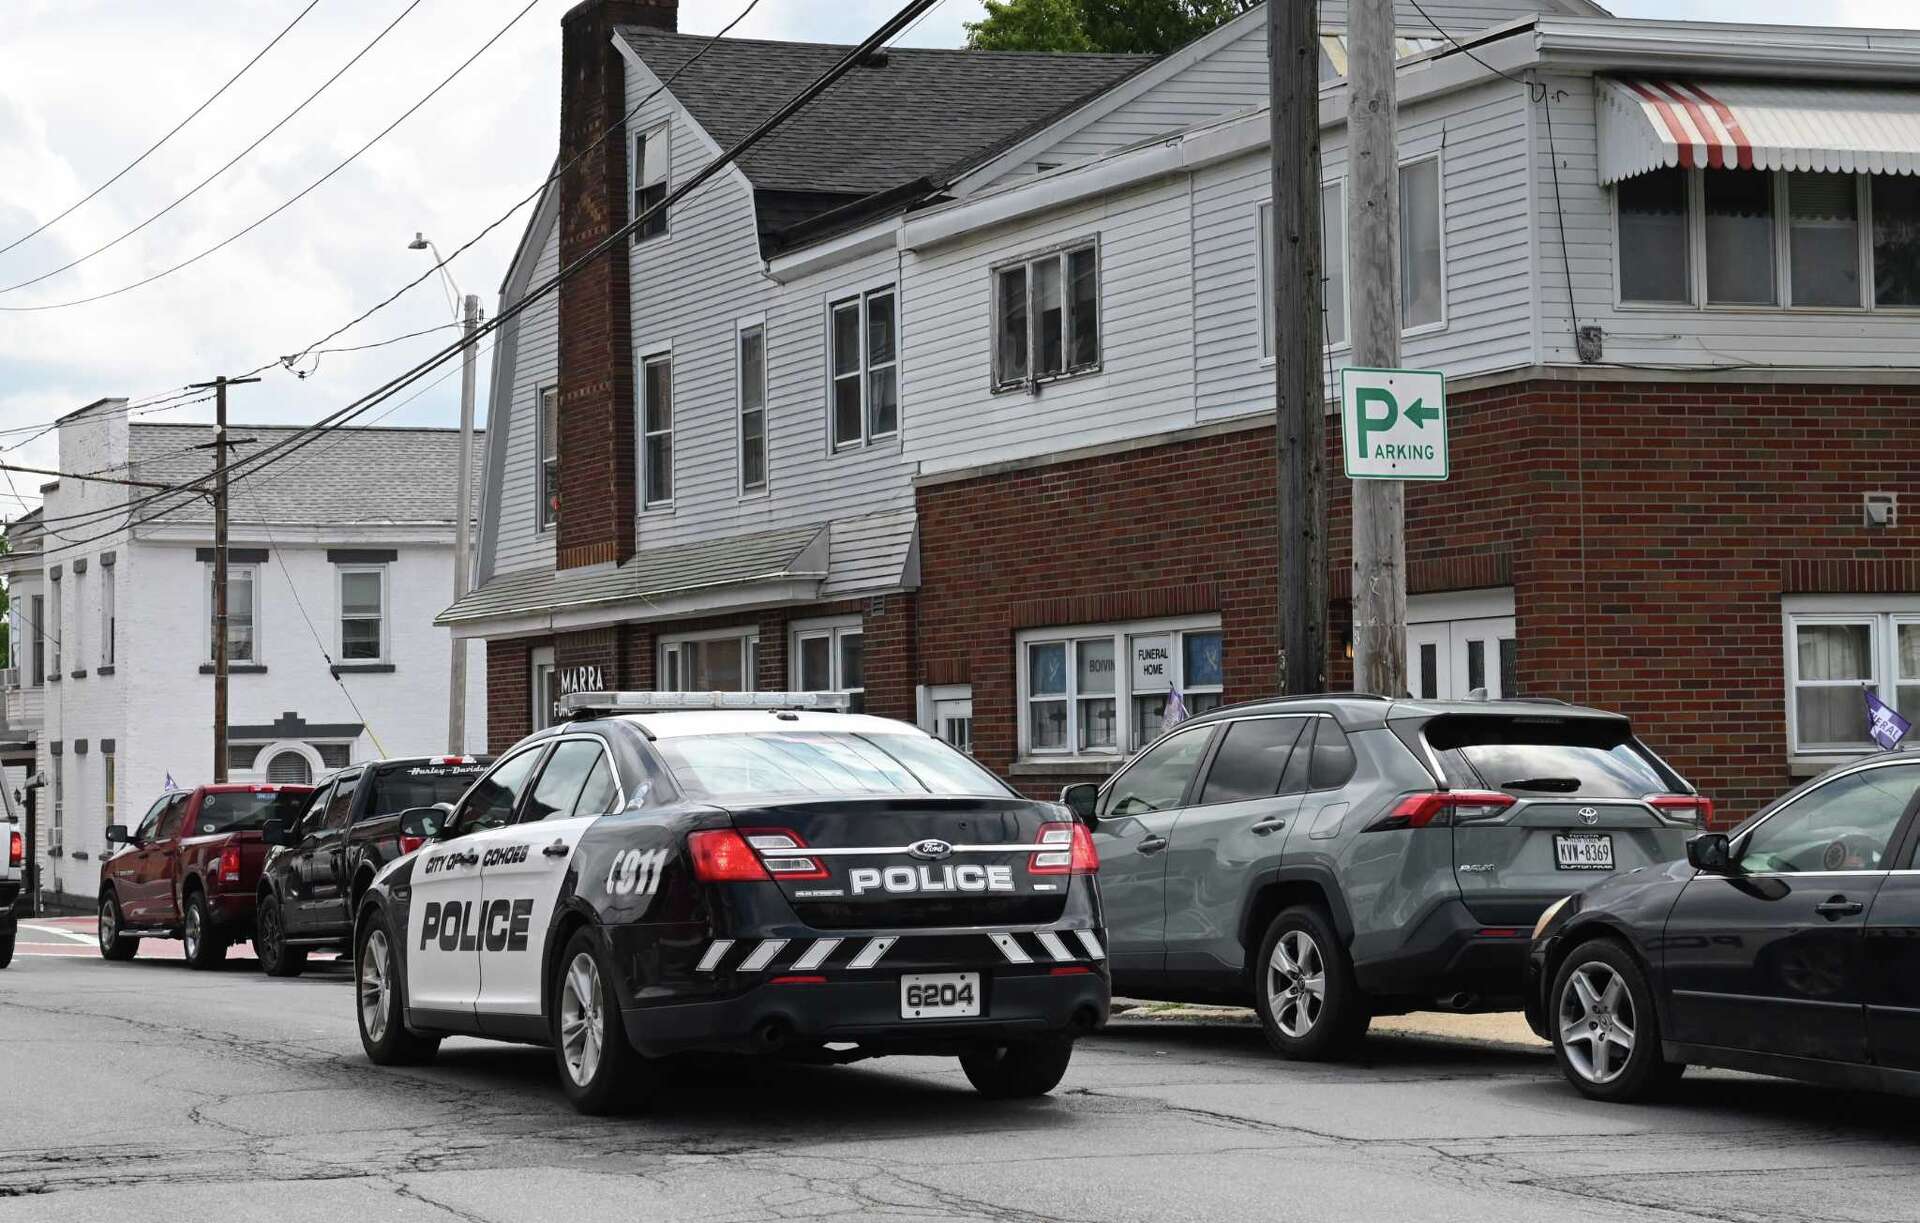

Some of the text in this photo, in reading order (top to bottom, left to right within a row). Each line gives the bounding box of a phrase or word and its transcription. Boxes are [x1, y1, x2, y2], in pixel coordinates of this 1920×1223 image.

[1089, 659, 1115, 673] BOIVIN
[1138, 648, 1168, 661] FUNERAL
[561, 666, 603, 693] MARRA
[1143, 664, 1163, 675] HOME
[425, 856, 448, 874] CITY
[482, 845, 529, 867] COHOES
[922, 842, 944, 853] Ford
[849, 864, 1015, 896] POLICE
[420, 899, 534, 952] POLICE
[906, 984, 974, 1008] 6204
